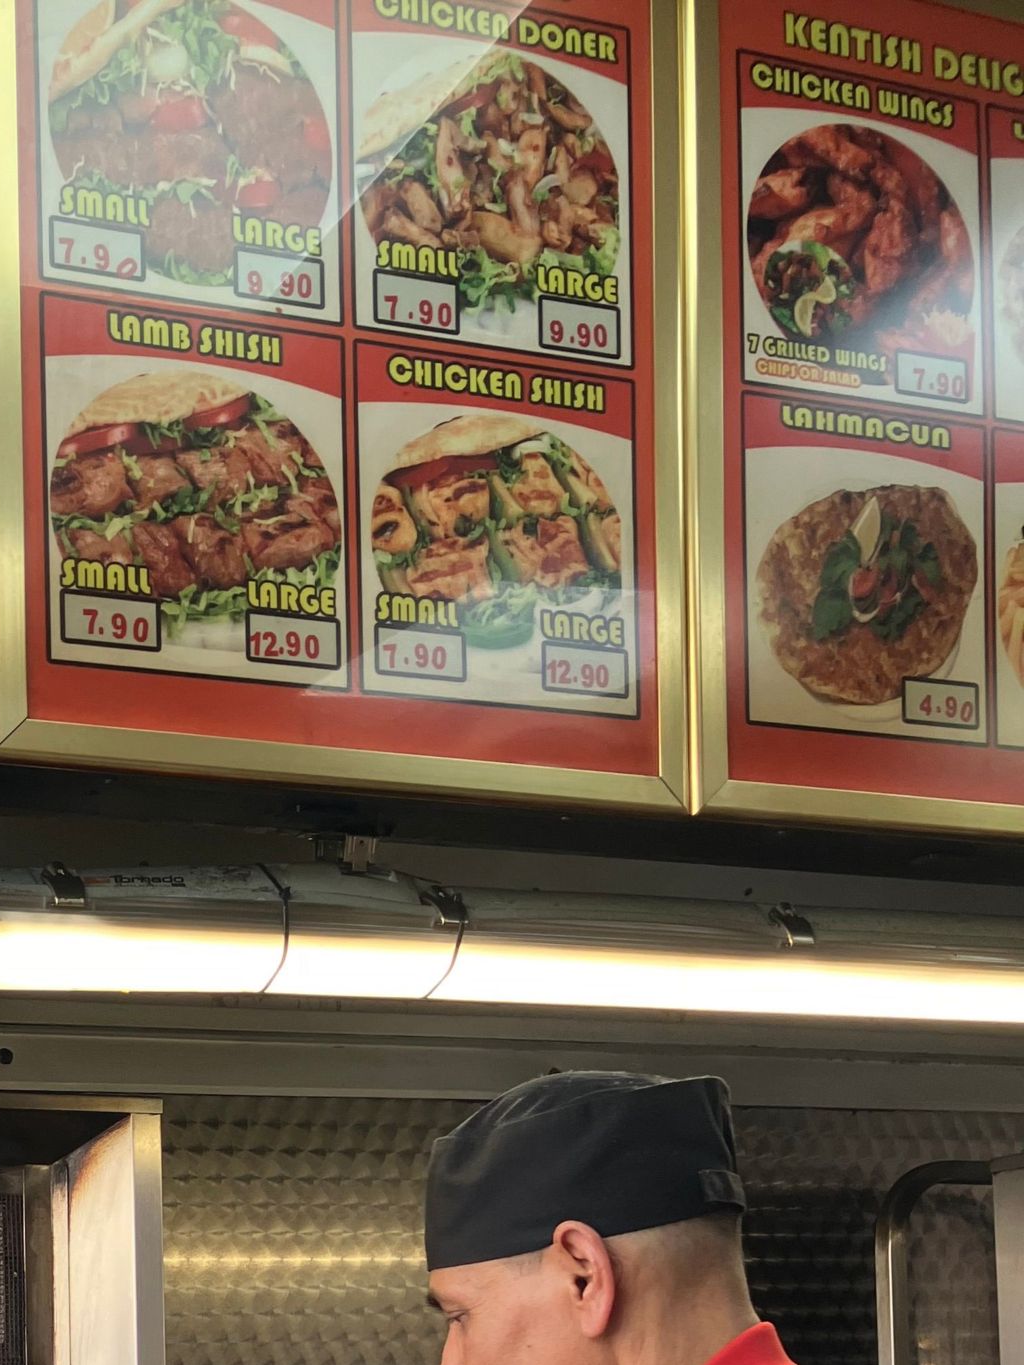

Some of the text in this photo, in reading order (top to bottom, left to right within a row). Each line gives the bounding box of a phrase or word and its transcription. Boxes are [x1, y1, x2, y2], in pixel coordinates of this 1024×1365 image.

[376, 0, 617, 62] CHICKEN DONER
[784, 11, 922, 74] KENTISH
[751, 62, 954, 128] CHICKEN WINGS
[59, 185, 150, 227] SMALL
[232, 213, 322, 257] LARGE
[58, 237, 138, 280] 7.90
[377, 239, 460, 278] SMALL
[537, 265, 619, 304] LARGE
[384, 295, 453, 328] 7.90
[108, 311, 282, 366] LAMB SHISH
[549, 320, 608, 349] 9.90
[747, 333, 887, 372] 7 GRILLED WINGS
[387, 355, 606, 413] CHICKEN SHISH
[756, 358, 796, 379] CHIPS
[913, 367, 964, 398] 7.90
[781, 404, 951, 449] LAHMACUN
[61, 558, 152, 595] SMALL
[246, 579, 337, 616] LARGE
[377, 593, 459, 628] SMALL
[82, 608, 149, 642] 7.90
[541, 610, 625, 646] LARGE
[250, 631, 320, 660] 12.90
[547, 659, 610, 688] 12.90
[919, 694, 974, 723] 4.90
